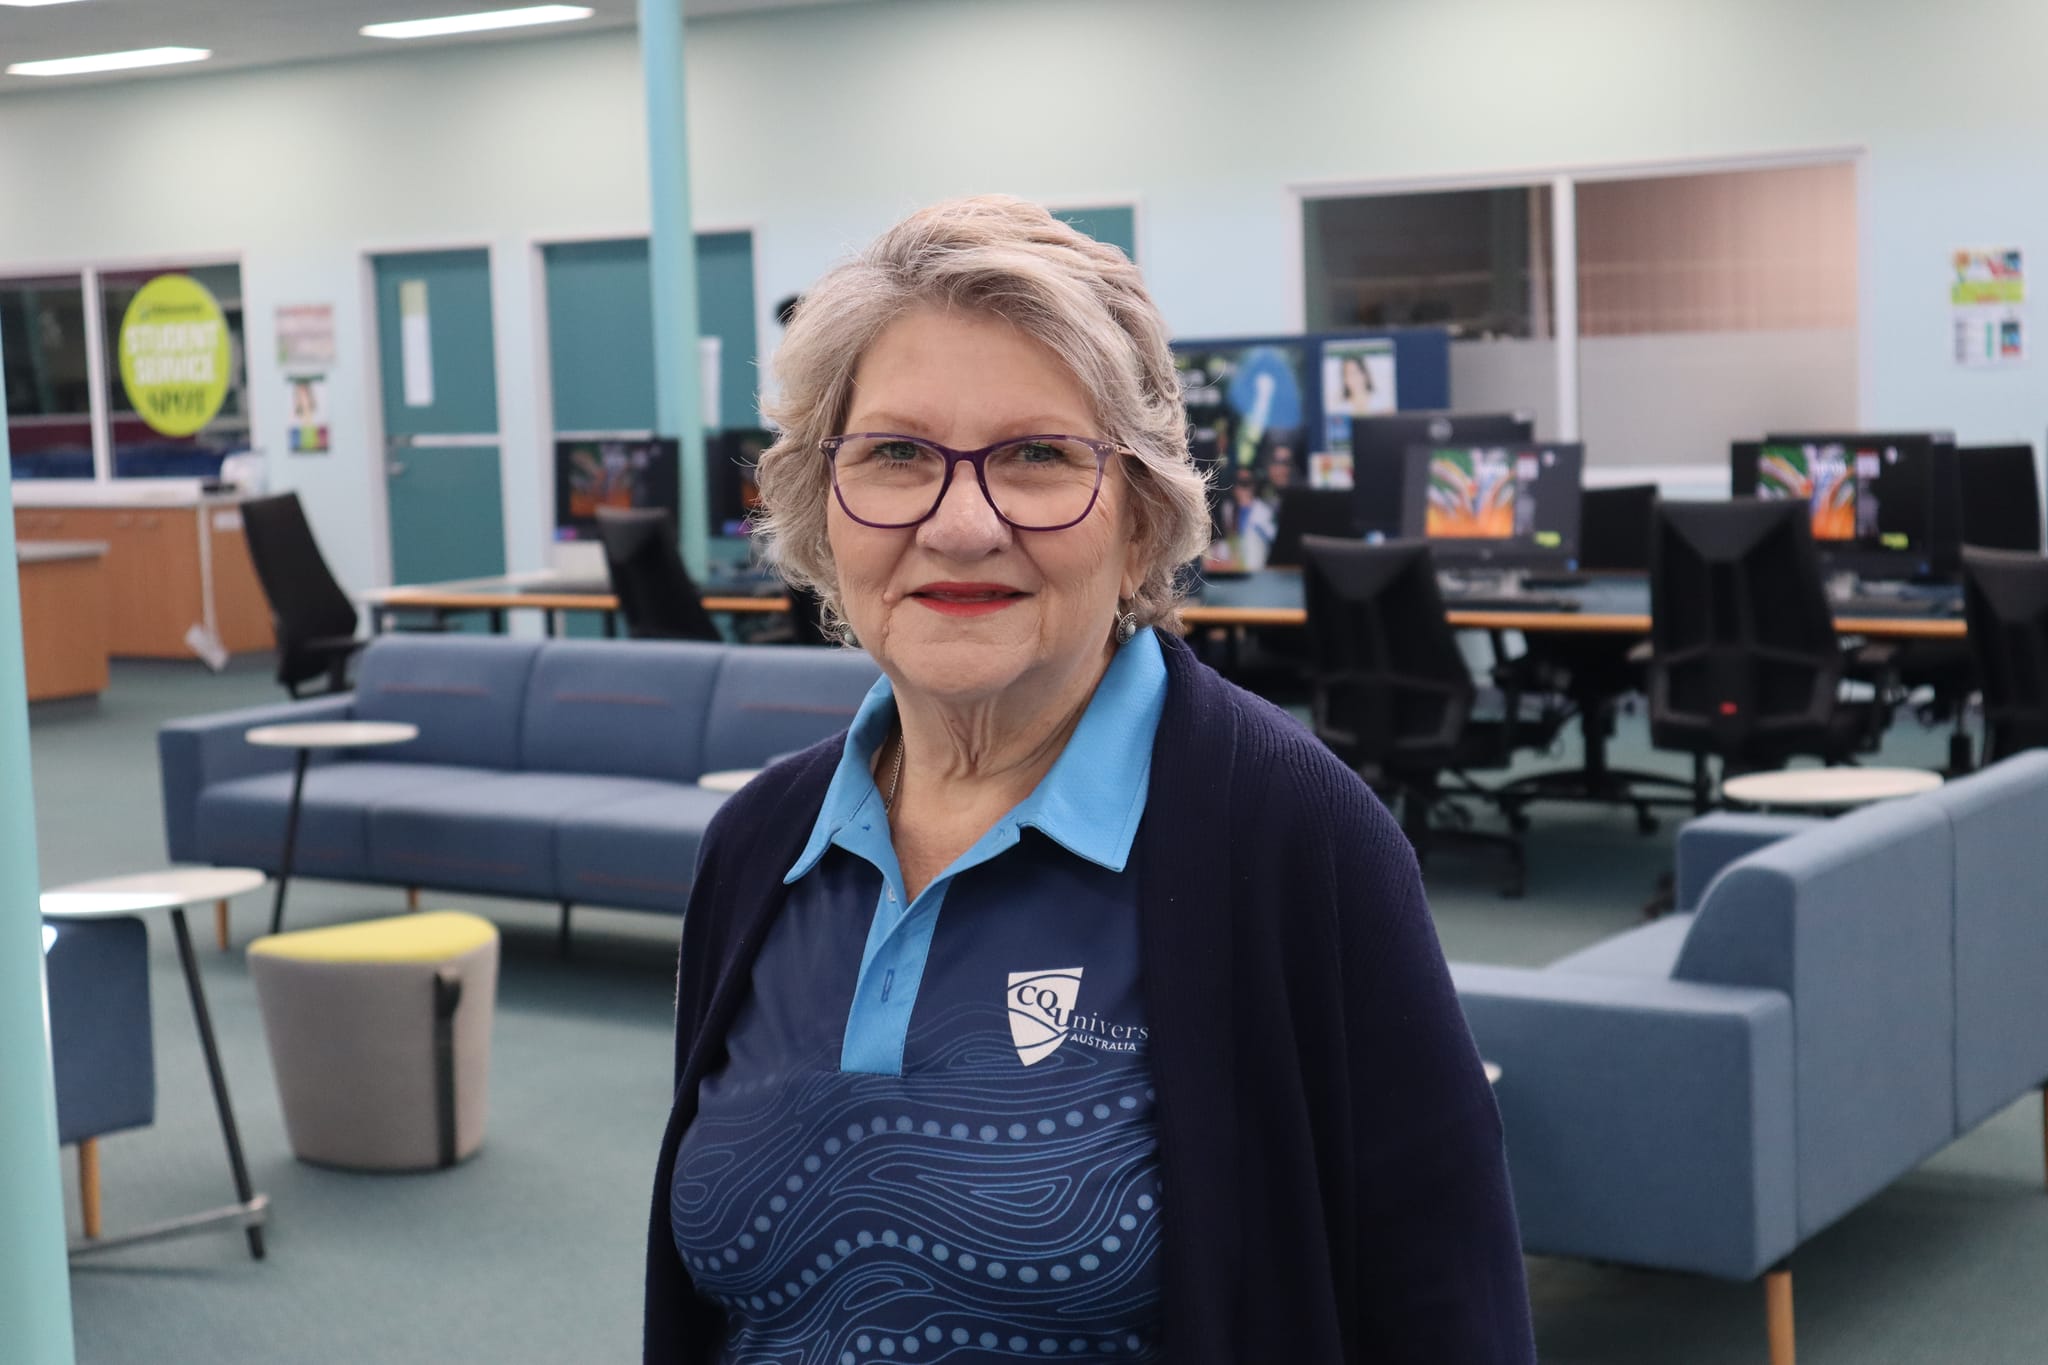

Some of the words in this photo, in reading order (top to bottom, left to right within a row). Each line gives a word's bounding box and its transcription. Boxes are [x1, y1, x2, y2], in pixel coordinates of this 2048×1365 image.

[125, 321, 219, 355] STUDENT
[134, 354, 216, 386] SERVICE
[1017, 985, 1149, 1041] CQUnivers
[1070, 1033, 1137, 1052] AUSTRALIA
